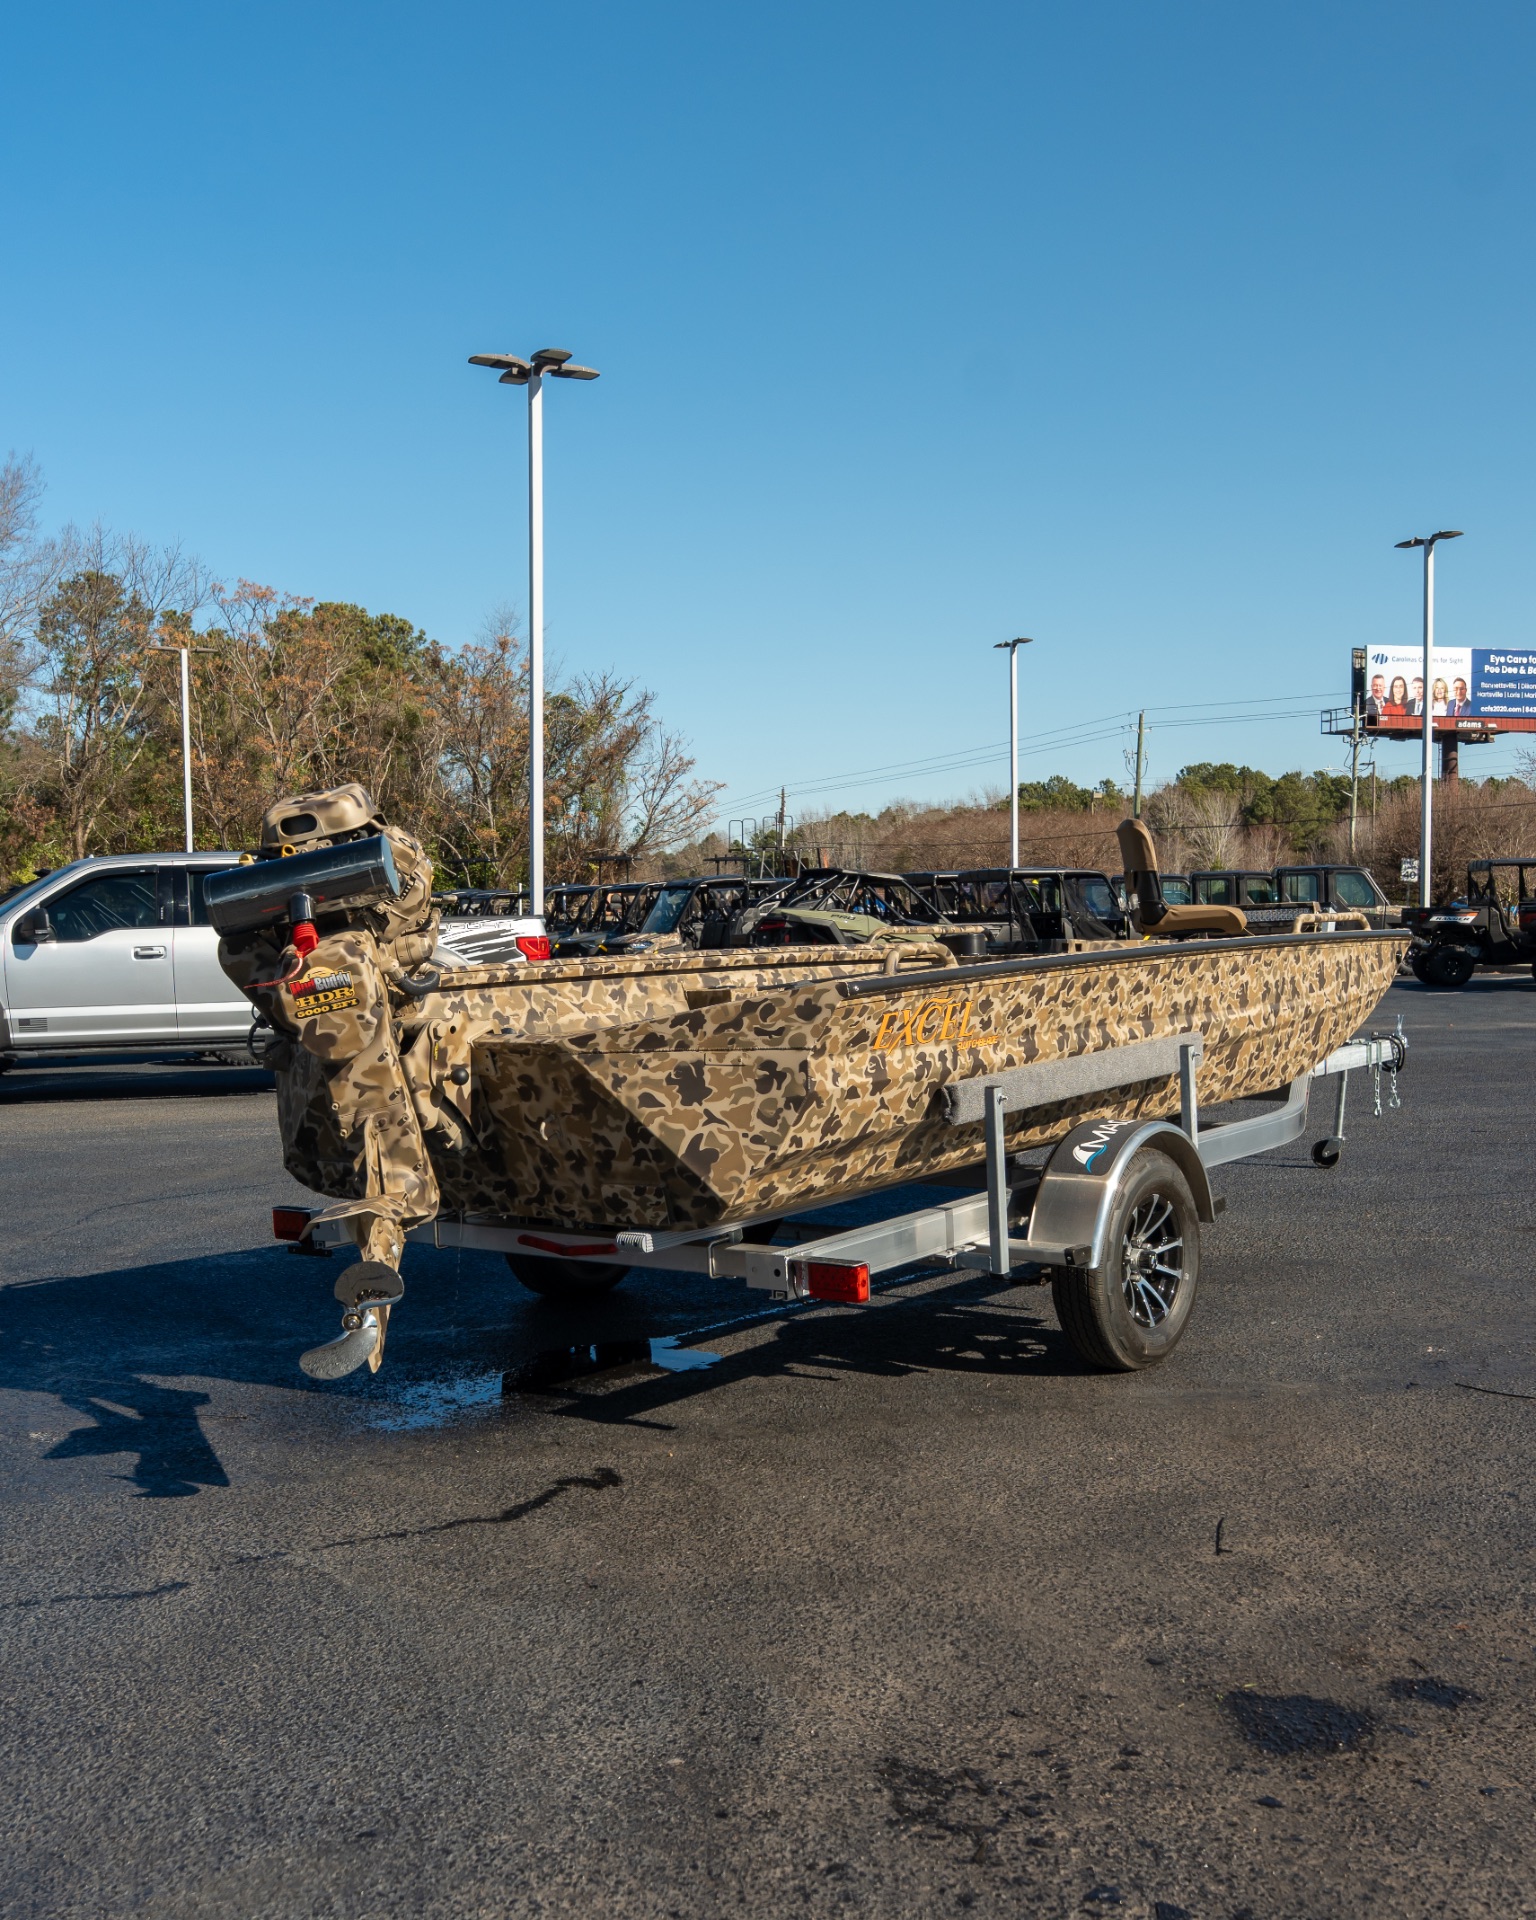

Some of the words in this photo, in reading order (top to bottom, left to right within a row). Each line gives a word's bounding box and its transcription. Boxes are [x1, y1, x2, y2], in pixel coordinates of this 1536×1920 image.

[1449, 657, 1463, 665] Sight
[1490, 655, 1505, 665] Eye
[1506, 655, 1527, 663] Care
[1484, 665, 1500, 674] Pee
[1501, 665, 1518, 674] Dee
[1519, 666, 1526, 674] &
[1458, 720, 1482, 728] adams
[295, 986, 354, 1008] HDR
[871, 996, 976, 1057] EXCEL
